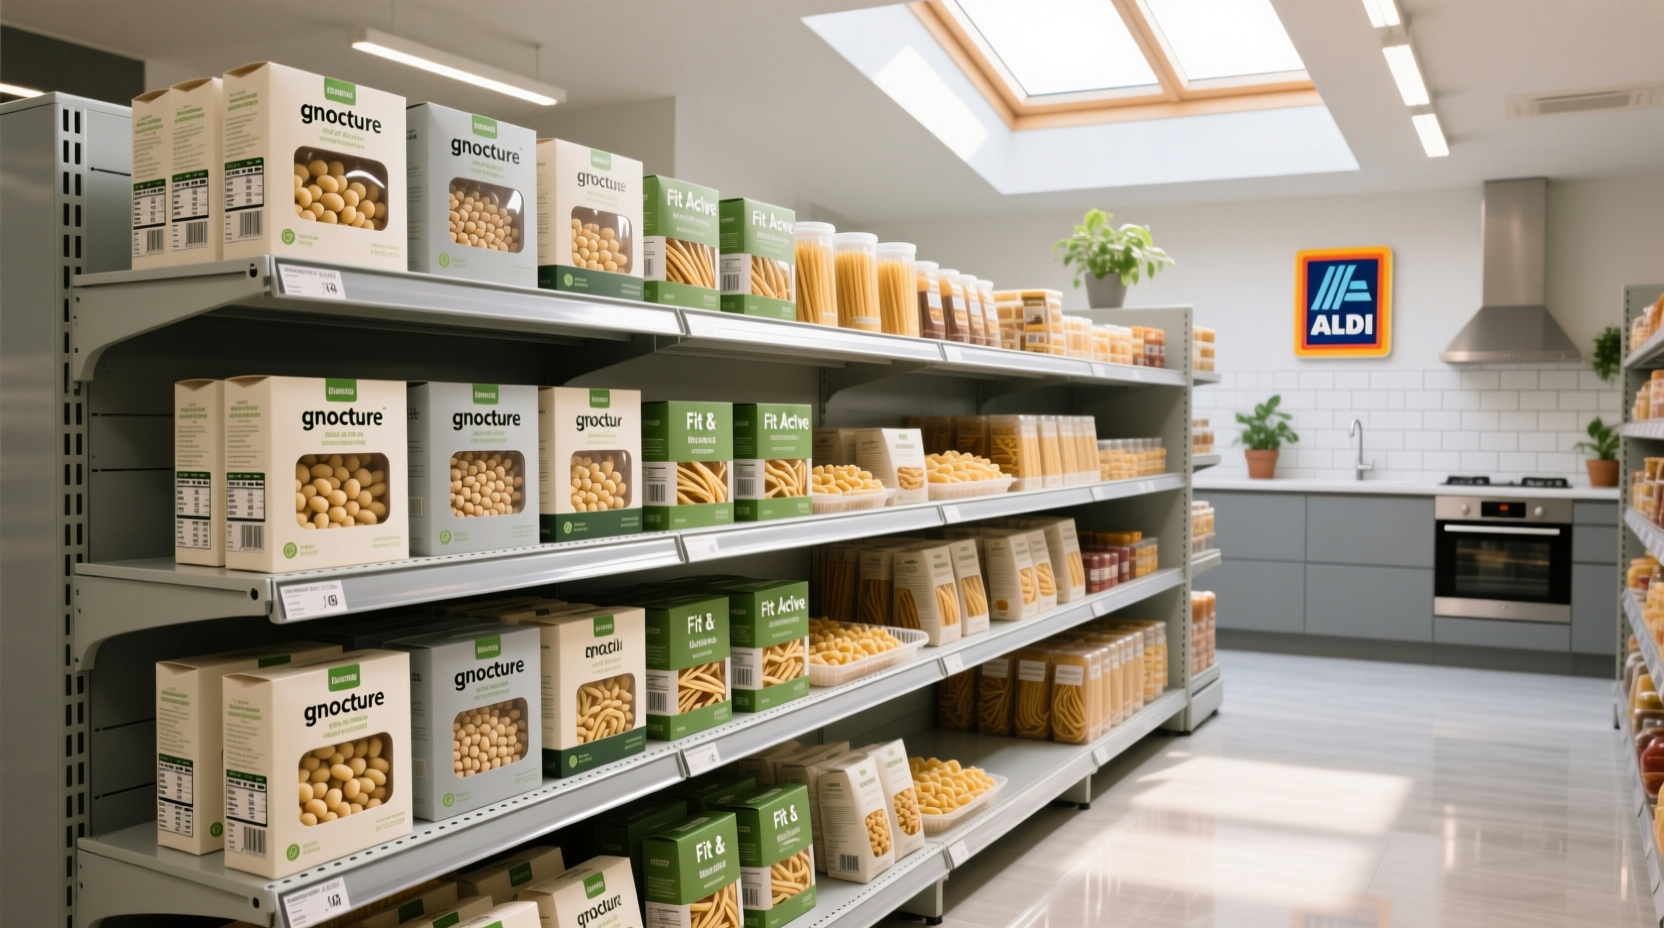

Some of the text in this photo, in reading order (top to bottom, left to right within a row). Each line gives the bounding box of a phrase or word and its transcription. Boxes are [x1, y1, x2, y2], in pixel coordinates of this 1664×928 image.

[301, 103, 381, 134] gnocture
[451, 138, 520, 165] gnocture
[667, 188, 683, 208] Fit
[752, 210, 766, 228] Fit
[1310, 313, 1373, 336] ALDI
[301, 407, 383, 431] gnocture
[452, 409, 521, 431] gnocture
[686, 411, 717, 431] Fit &
[764, 412, 778, 430] Fit
[761, 599, 775, 618] Fit
[687, 612, 715, 635] Fit &
[454, 659, 525, 691] gnocture
[303, 691, 385, 727] gnocture
[773, 804, 799, 830] Fit &
[696, 834, 726, 863] Fit &
